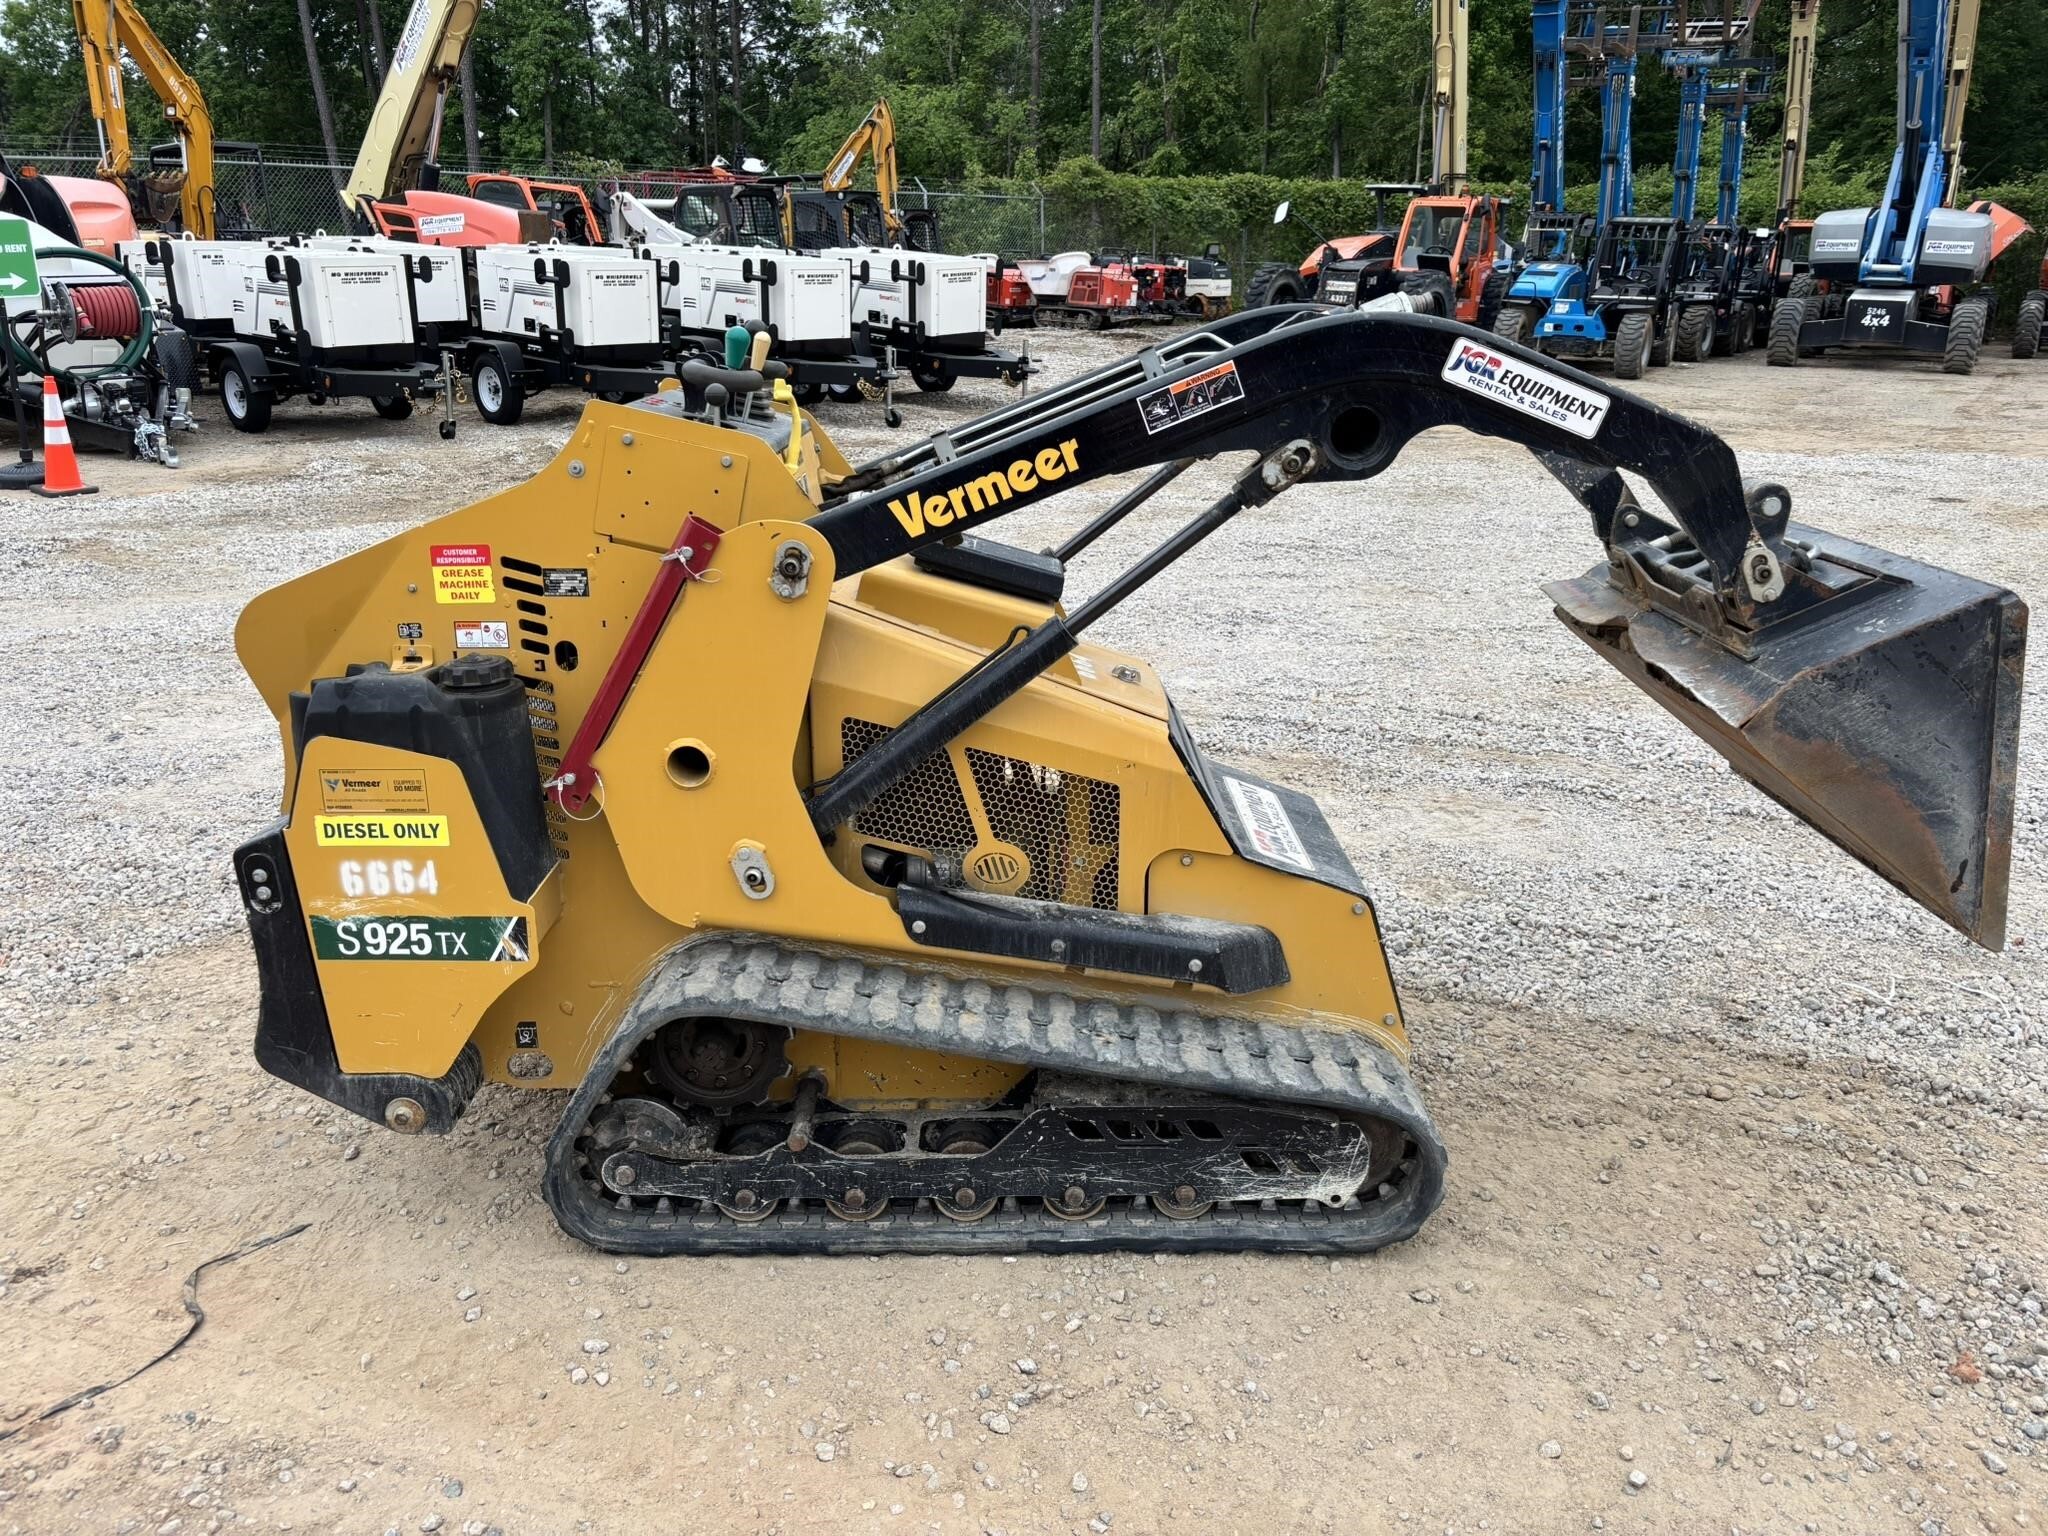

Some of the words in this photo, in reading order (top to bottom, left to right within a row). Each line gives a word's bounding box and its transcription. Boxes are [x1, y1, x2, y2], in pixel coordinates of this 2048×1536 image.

[5, 244, 27, 253] RENT
[1860, 314, 1890, 326] 4x4
[1191, 368, 1220, 384] WARNING
[1448, 346, 1503, 382] JGR
[1498, 369, 1603, 421] EQUIPMENT
[1468, 375, 1514, 401] RENTAL
[1516, 396, 1525, 405] &
[1528, 401, 1568, 422] SALES
[886, 438, 1080, 538] Vermeer
[442, 569, 484, 577] GREASE
[440, 580, 489, 589] MACHINE
[450, 592, 480, 600] DAILY
[342, 779, 381, 787] Vermeer
[323, 823, 389, 839] DIESEL
[394, 823, 440, 839] ONLY
[340, 859, 438, 897] 6664
